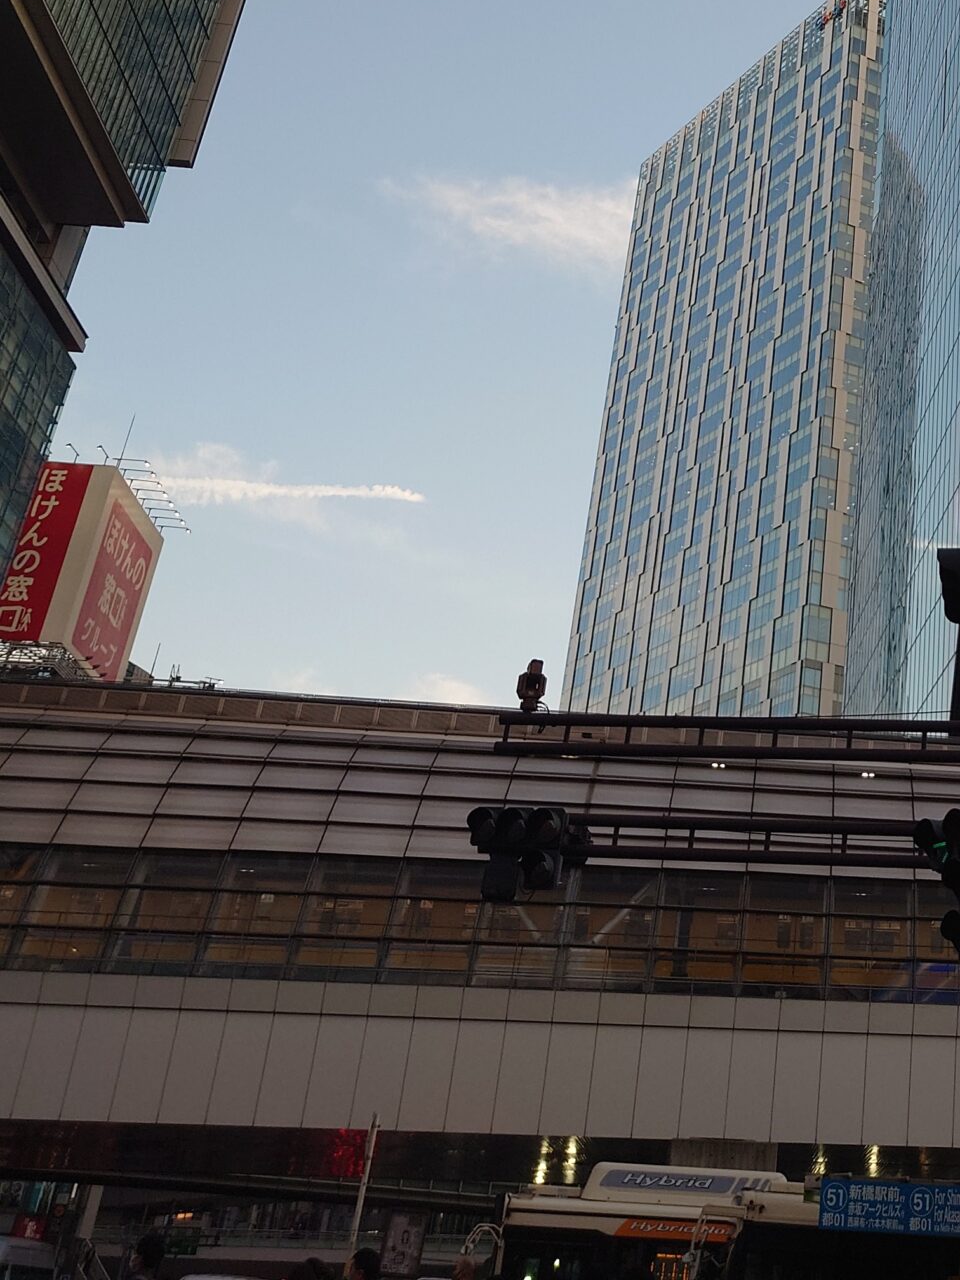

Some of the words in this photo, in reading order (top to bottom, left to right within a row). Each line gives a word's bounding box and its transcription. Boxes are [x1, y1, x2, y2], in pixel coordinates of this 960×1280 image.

[0, 468, 67, 632] ほけんの窓口
[103, 514, 146, 591] ほけんの
[97, 573, 125, 630] 窓口
[623, 1173, 713, 1189] Hybrid
[826, 1188, 844, 1207] 51
[913, 1193, 930, 1211] 51
[934, 1188, 946, 1205] For
[821, 1212, 845, 1227] 都01
[933, 1205, 944, 1222] For
[909, 1217, 931, 1231] 都01
